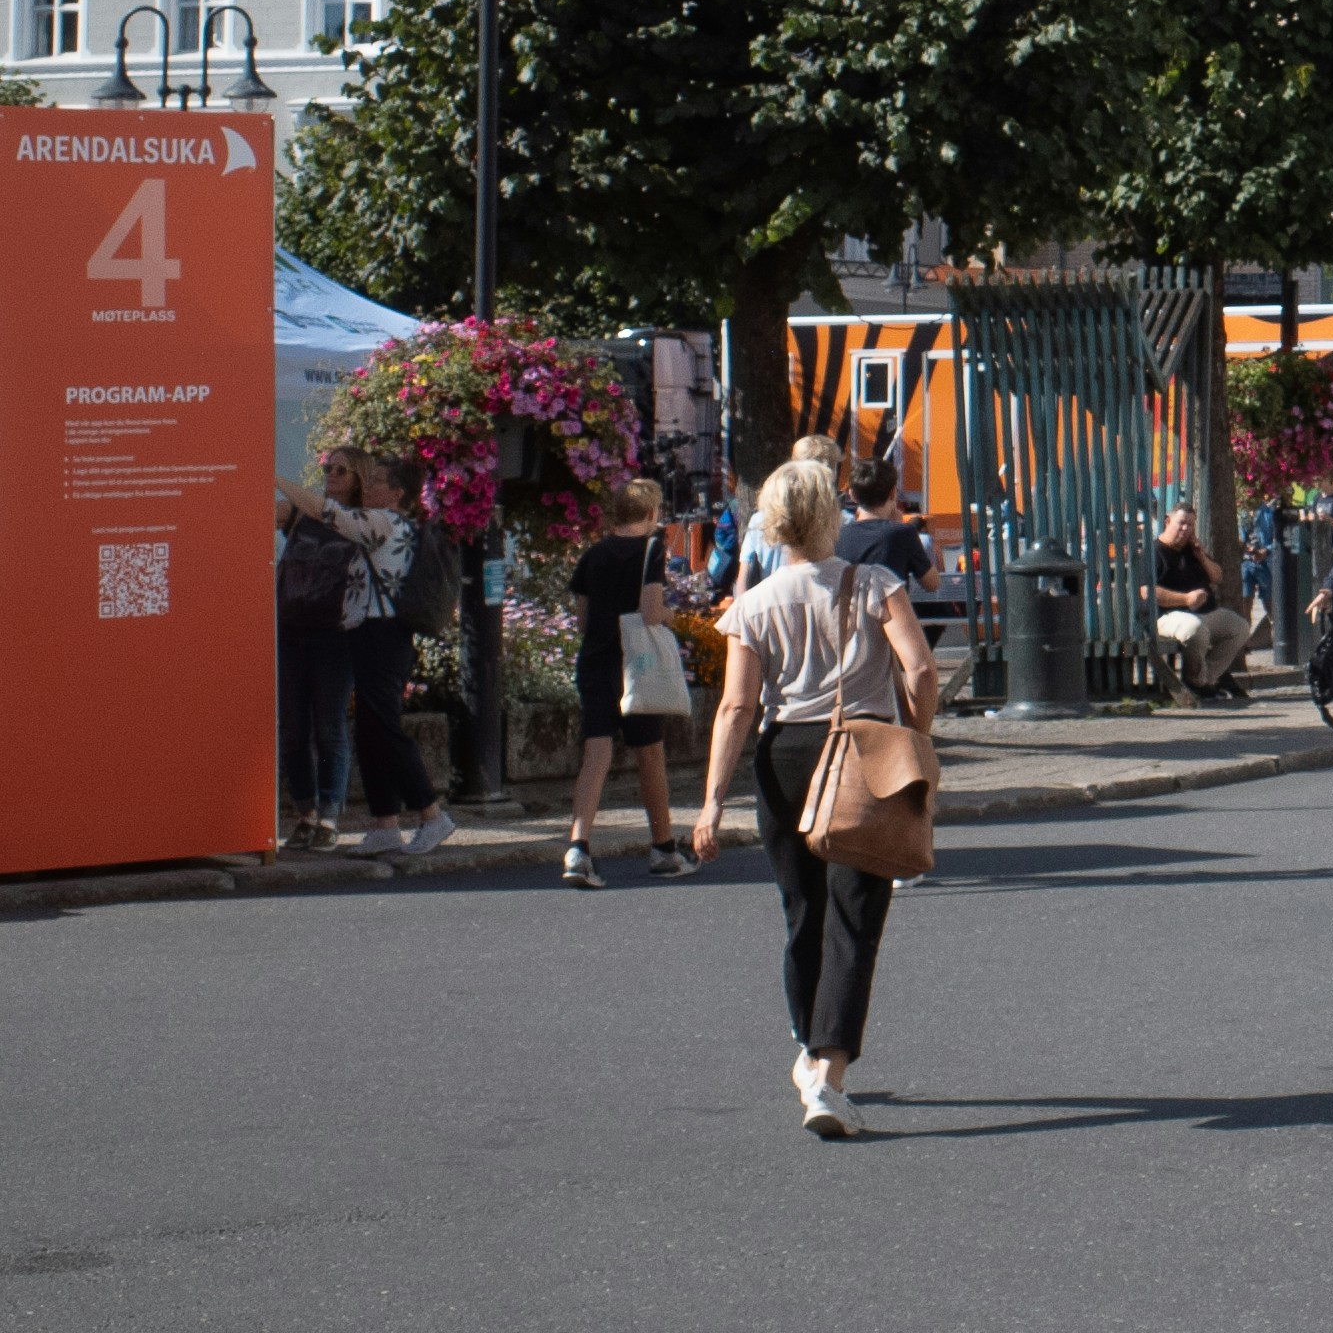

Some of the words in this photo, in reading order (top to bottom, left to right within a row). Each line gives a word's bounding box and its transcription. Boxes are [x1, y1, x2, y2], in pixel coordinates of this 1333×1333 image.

[16, 134, 215, 165] ARENDALSUKA
[87, 179, 181, 307] 4
[92, 309, 176, 322] MØTEPLASS
[66, 385, 210, 405] PROGRAM-APP
